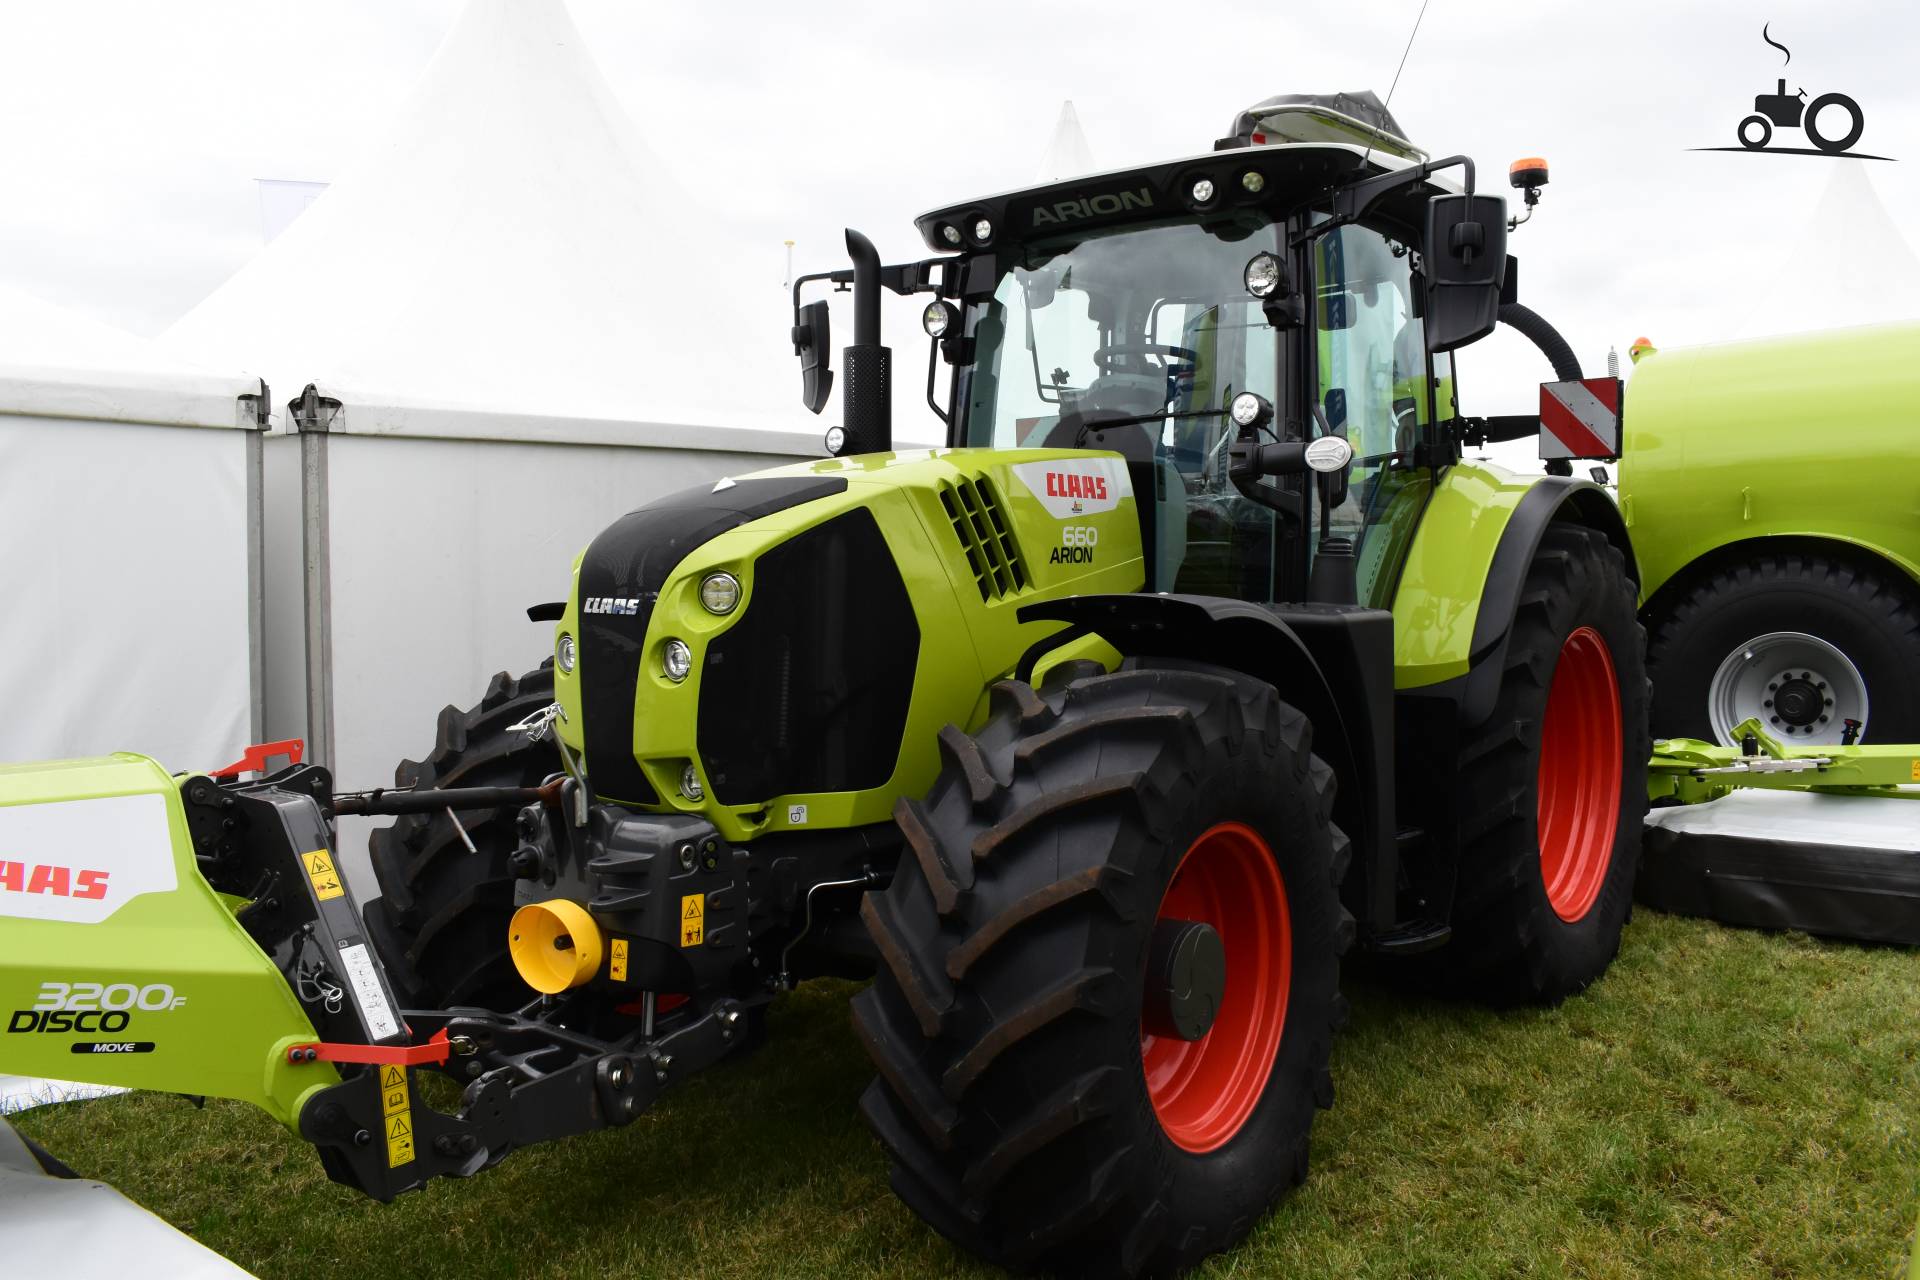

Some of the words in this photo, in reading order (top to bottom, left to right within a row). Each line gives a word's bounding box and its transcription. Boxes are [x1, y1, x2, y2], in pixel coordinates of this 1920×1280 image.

[1046, 472, 1107, 500] CLAAS
[1062, 526, 1098, 547] 660
[1049, 546, 1093, 564] ARION
[583, 597, 640, 615] CLAAS
[0, 860, 110, 900] AAS
[7, 1010, 131, 1033] DISCO
[92, 1043, 136, 1053] MOVE
